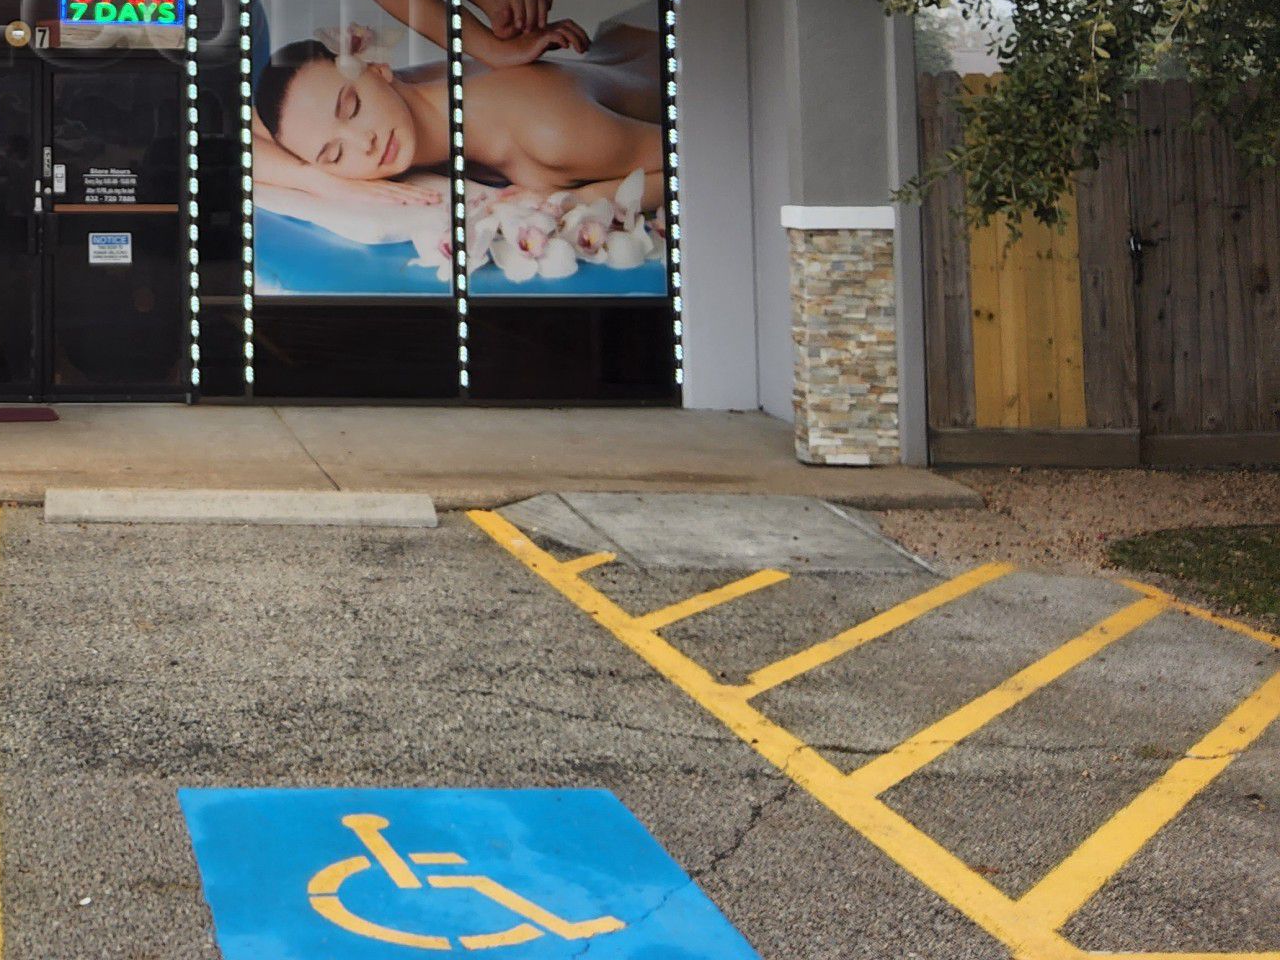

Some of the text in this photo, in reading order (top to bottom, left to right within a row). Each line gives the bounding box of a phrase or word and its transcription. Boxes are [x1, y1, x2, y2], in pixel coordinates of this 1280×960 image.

[69, 2, 176, 23] 7 DAYS
[37, 28, 47, 48] 7
[93, 235, 128, 244] NOTICE
